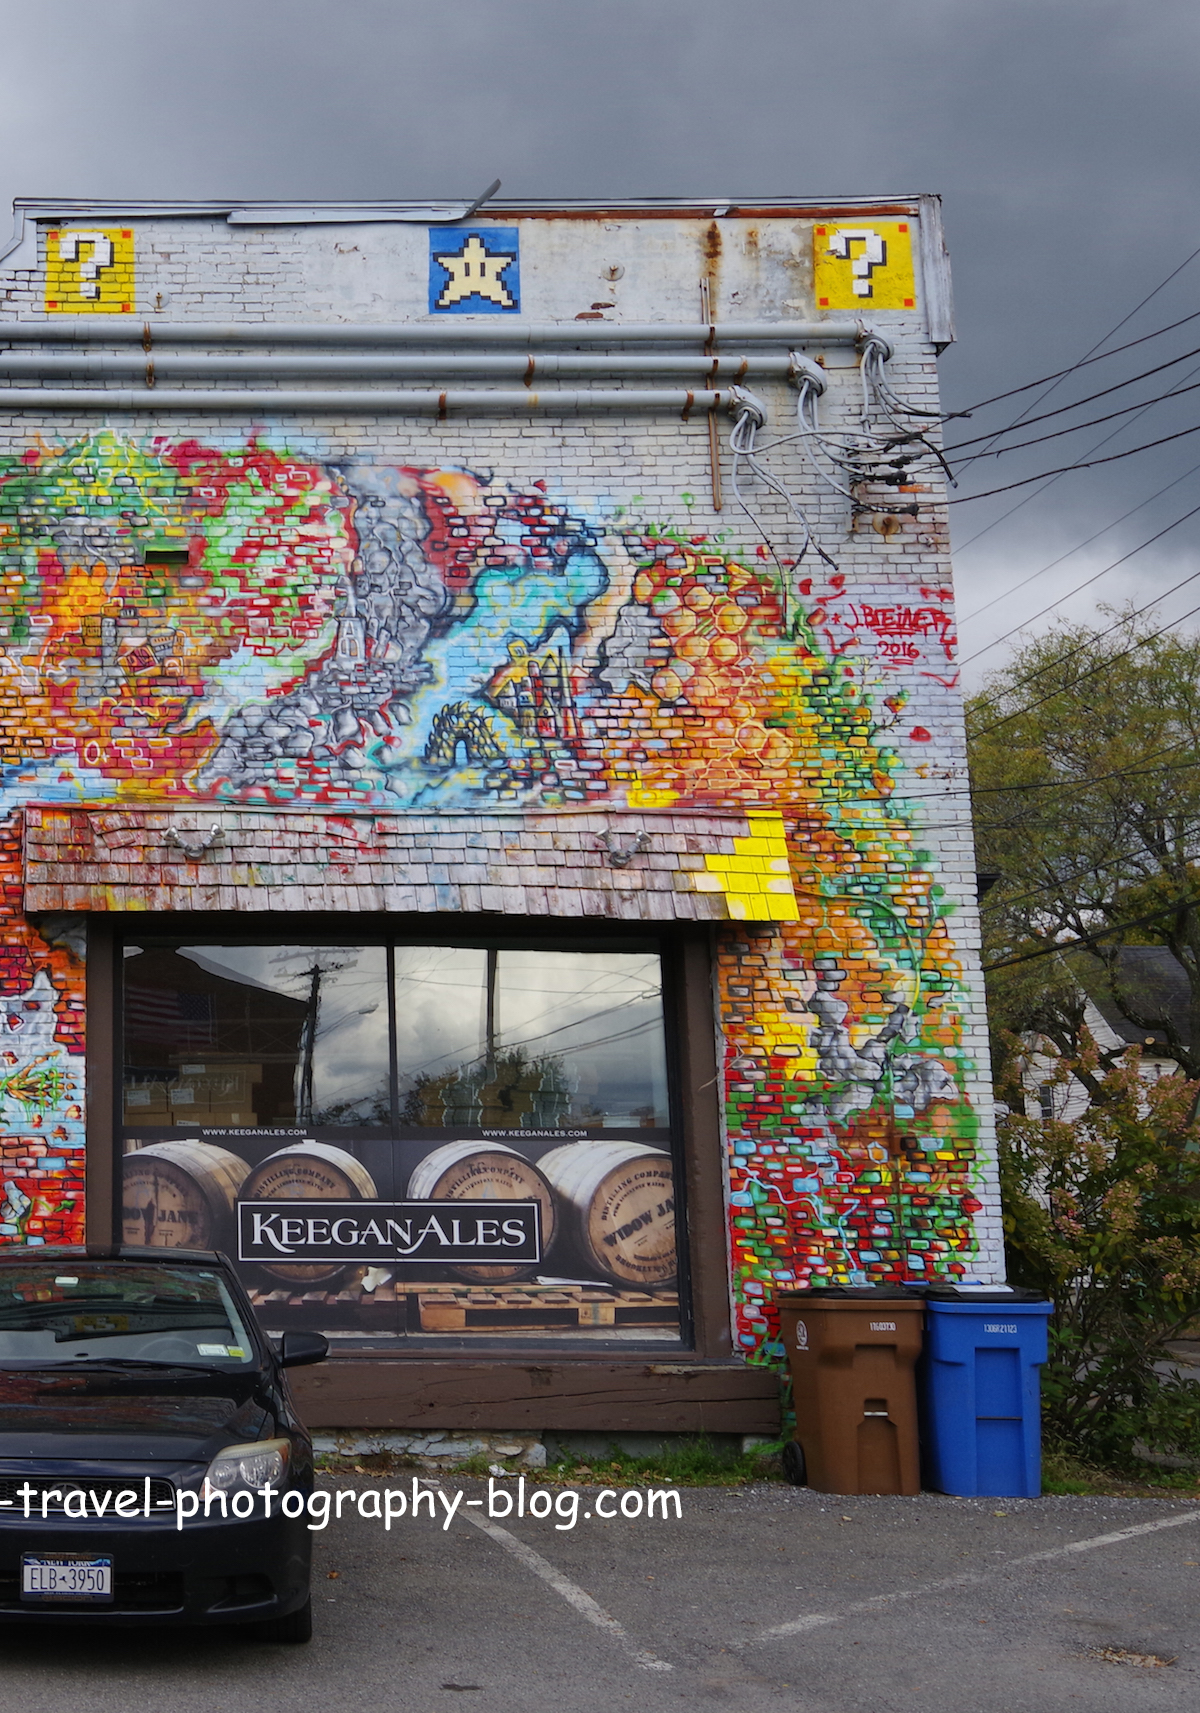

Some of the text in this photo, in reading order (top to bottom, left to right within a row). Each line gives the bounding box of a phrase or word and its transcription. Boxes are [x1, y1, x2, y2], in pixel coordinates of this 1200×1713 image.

[878, 640, 920, 659] 2016
[202, 1128, 307, 1136] WWW.KEEGANALES.COM
[482, 1129, 587, 1137] WWW.KEEGANALES.COM
[296, 1167, 336, 1190] COMPANY
[601, 1177, 633, 1221] DISTILLING
[603, 1196, 675, 1247] WIDOW JA
[252, 1213, 526, 1254] KEEGAN ALES
